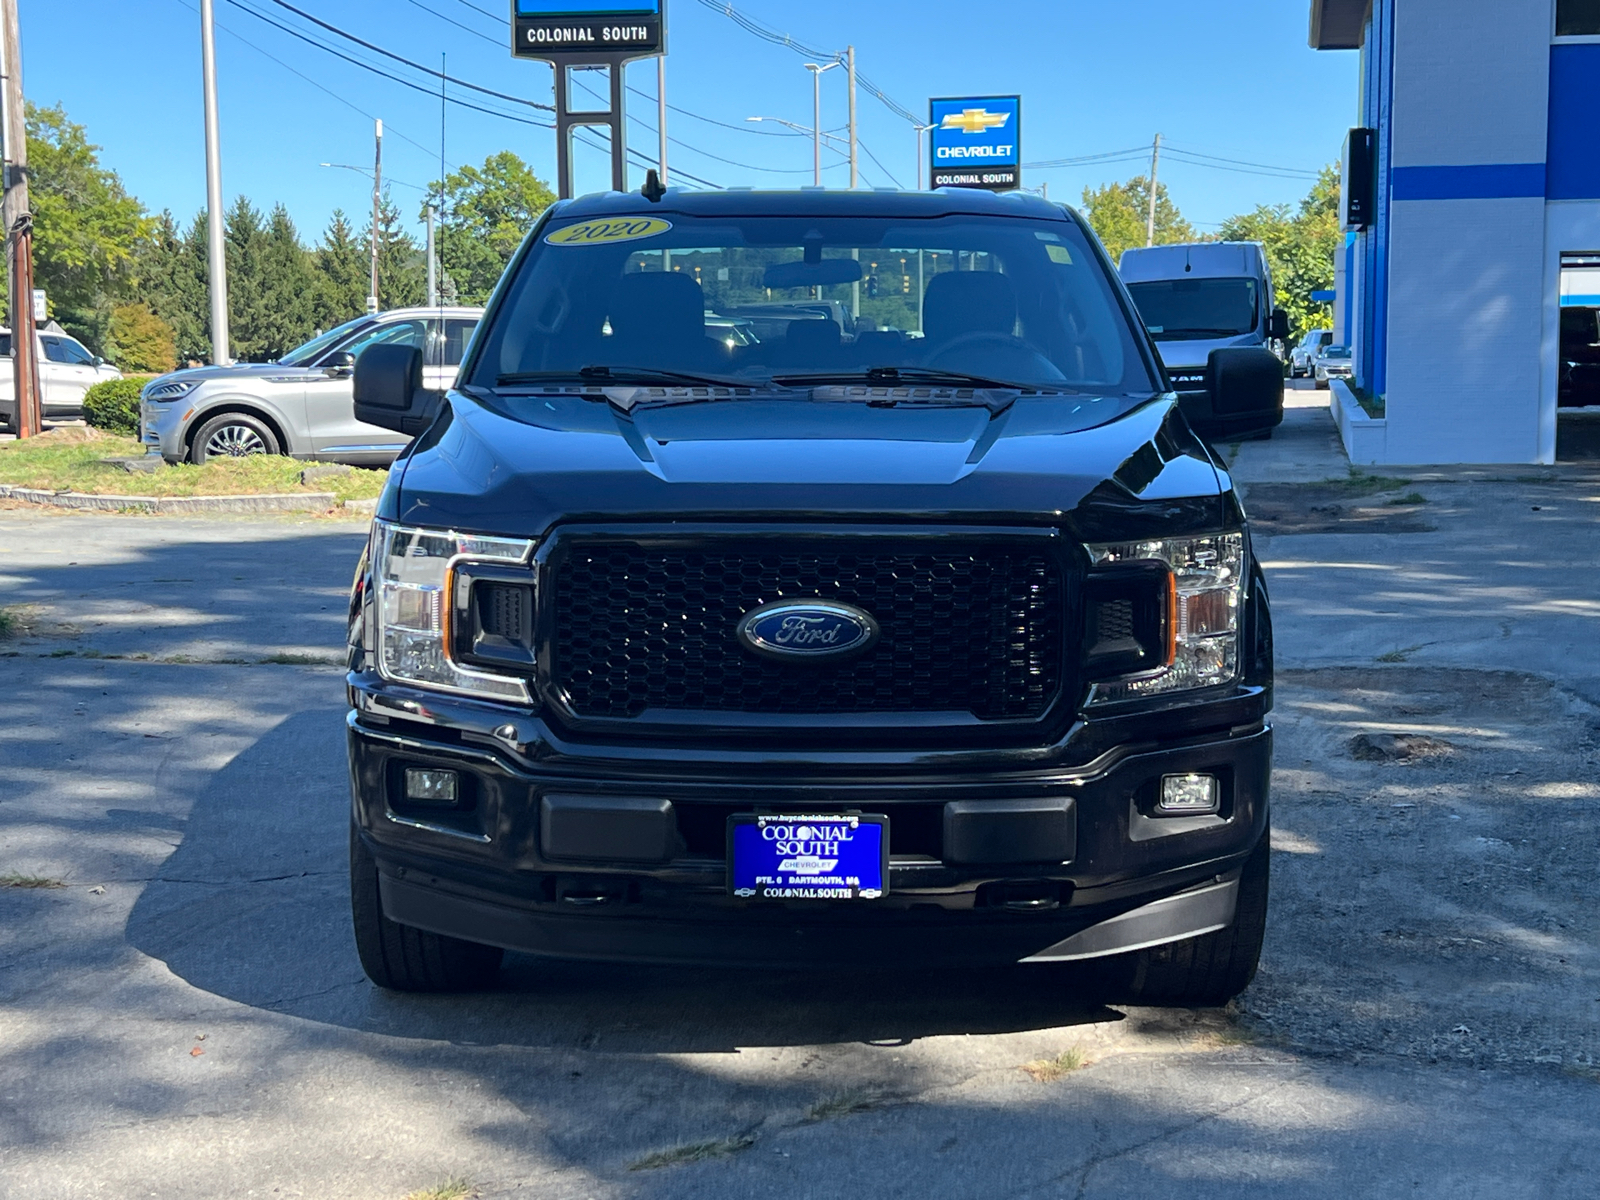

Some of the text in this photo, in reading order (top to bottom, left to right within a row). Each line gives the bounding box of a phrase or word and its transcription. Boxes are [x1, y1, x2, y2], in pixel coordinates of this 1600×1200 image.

[527, 26, 648, 42] COLONIAL SOUTH
[937, 145, 1013, 158] CHEVROLET
[936, 173, 1014, 184] COLONIAL SOUTH
[563, 220, 652, 242] 2020
[775, 616, 841, 644] Ford
[762, 825, 853, 841] COLONIAL
[776, 841, 839, 855] SOUTH
[763, 888, 853, 898] COLONIAL SOUTH
